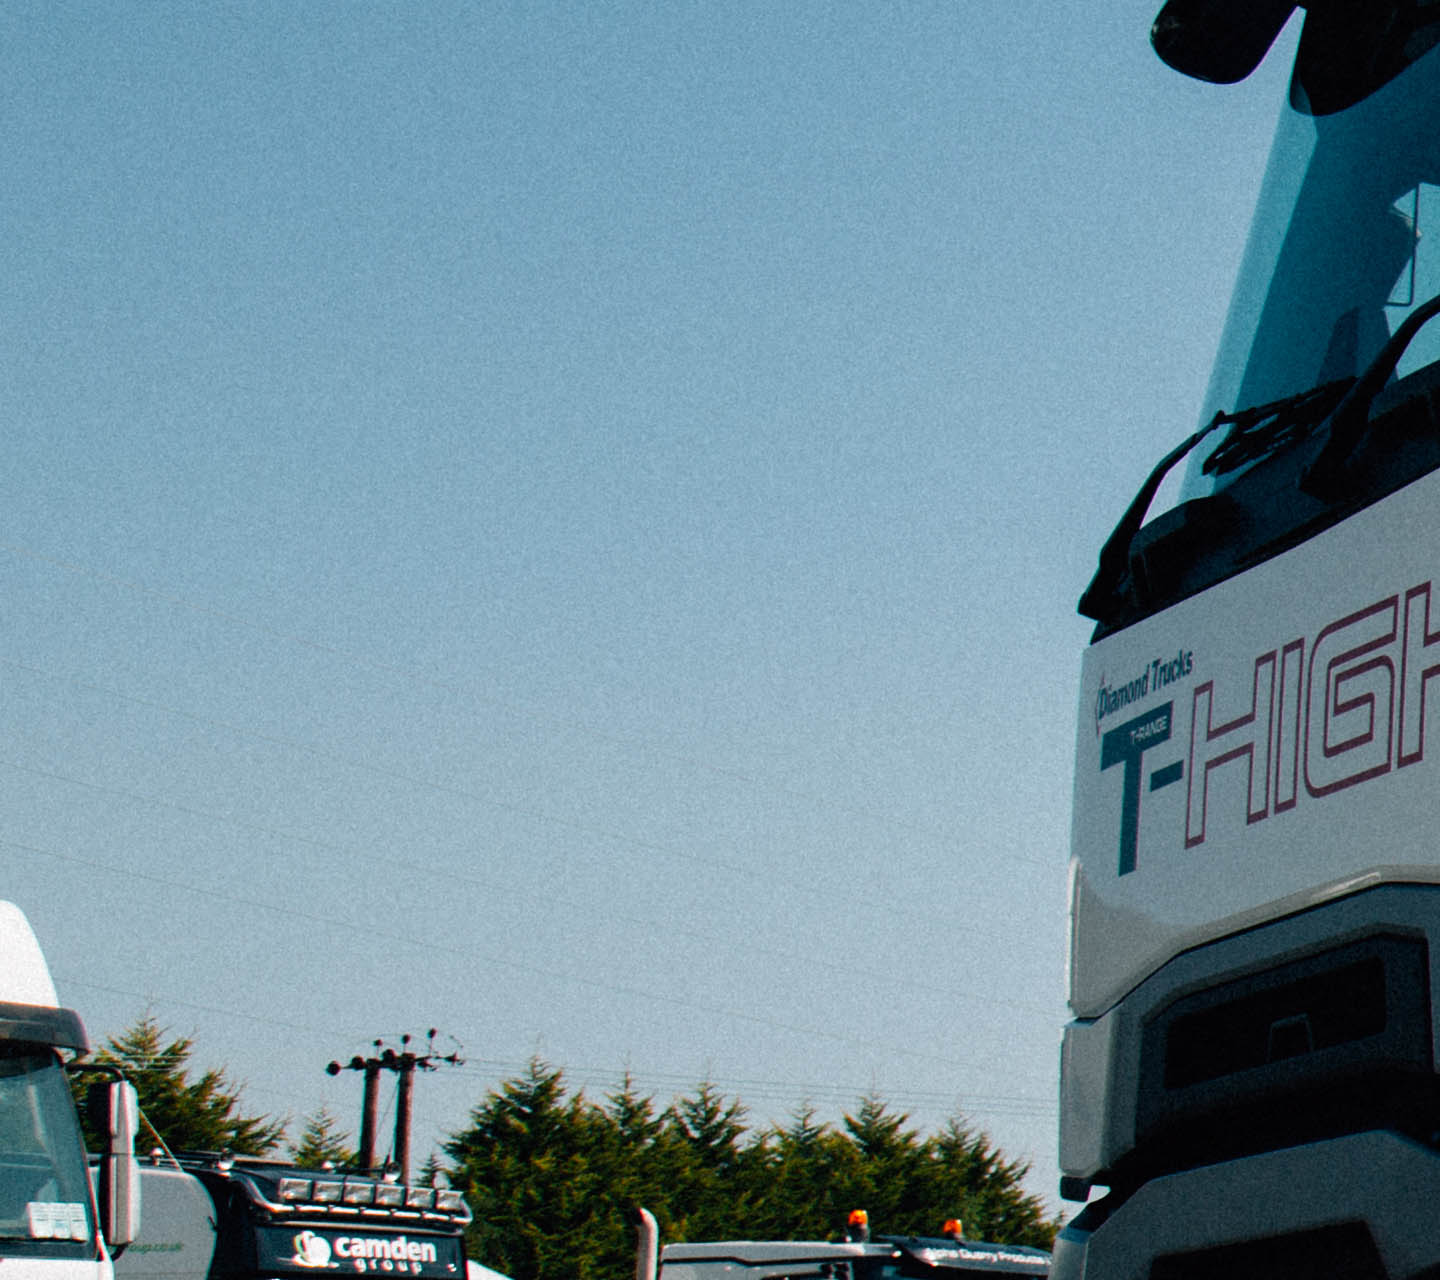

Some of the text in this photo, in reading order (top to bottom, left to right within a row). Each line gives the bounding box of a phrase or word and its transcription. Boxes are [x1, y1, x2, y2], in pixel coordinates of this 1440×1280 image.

[1099, 648, 1194, 721] Diamond Trucks
[333, 1235, 438, 1263] camden
[354, 1258, 423, 1275] group
